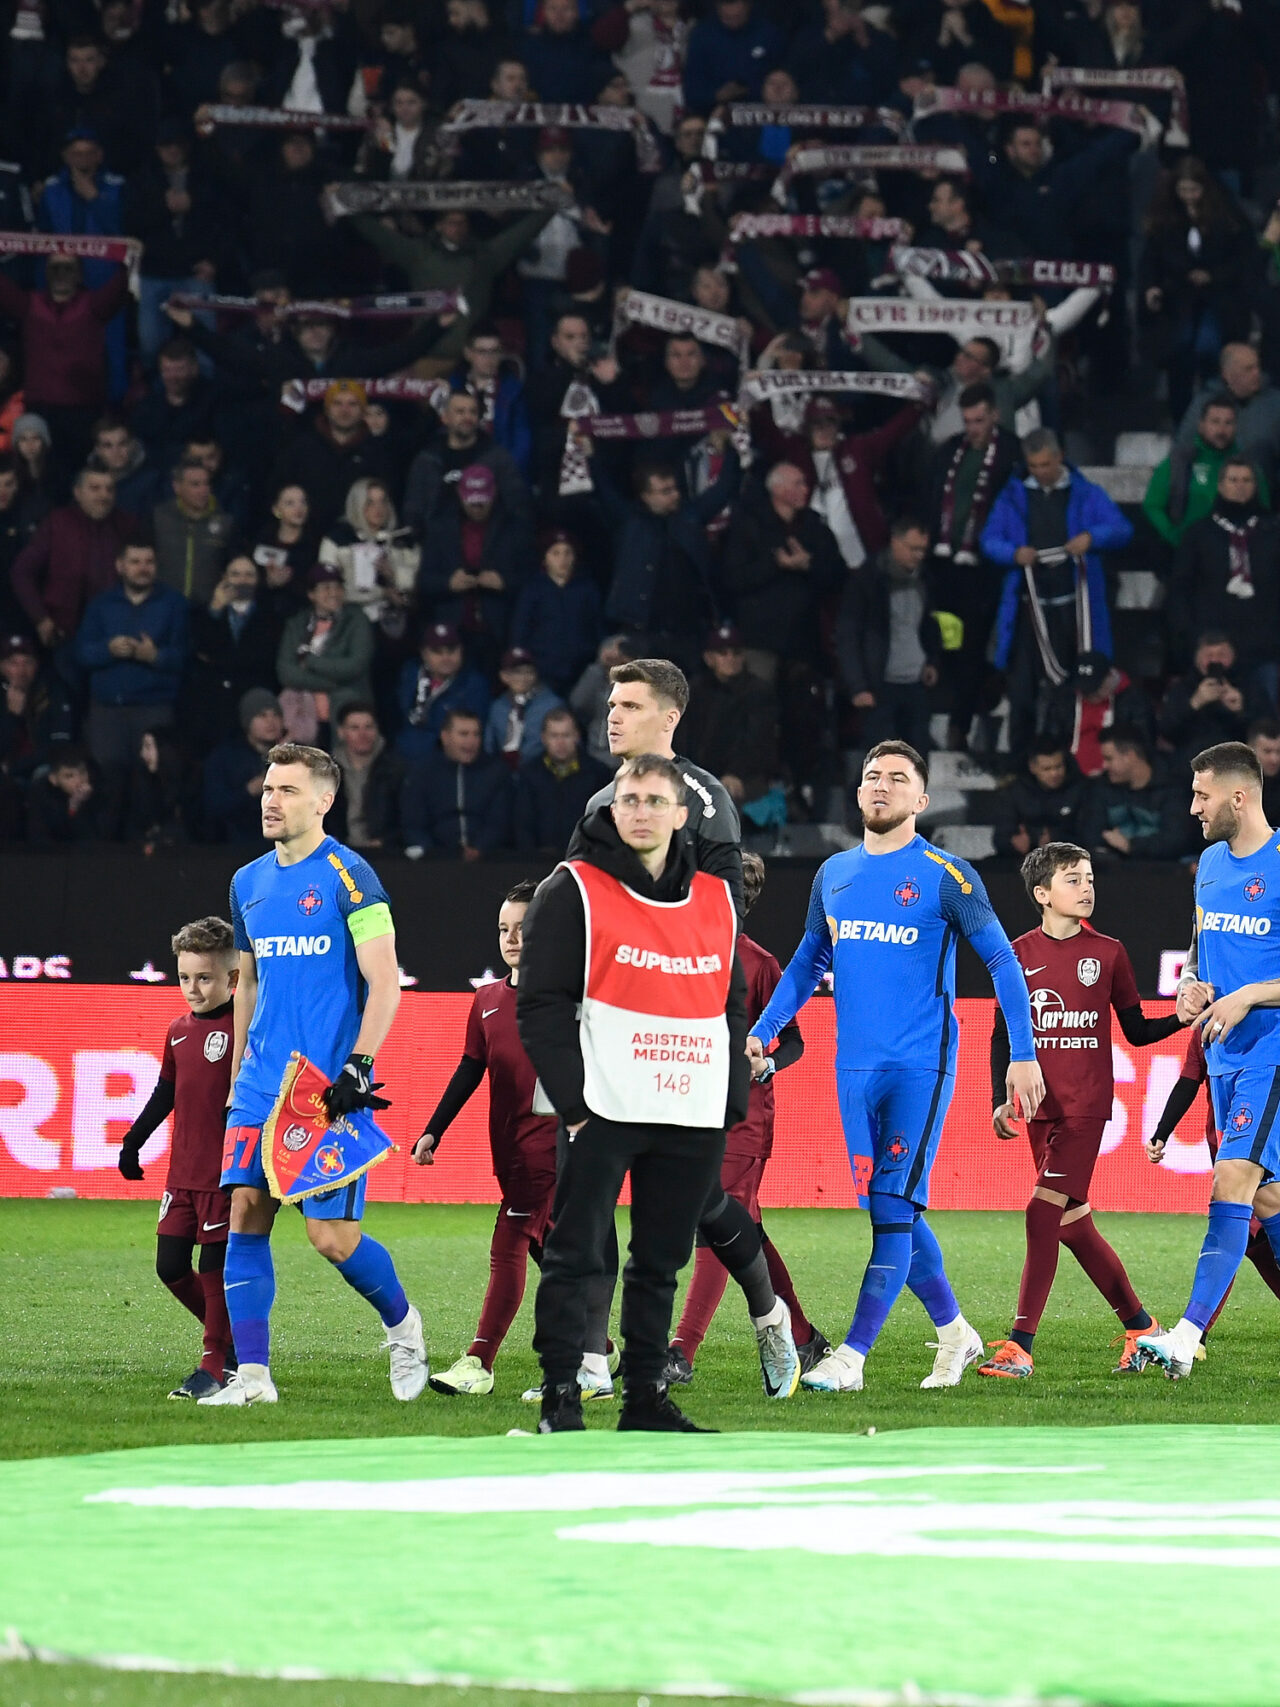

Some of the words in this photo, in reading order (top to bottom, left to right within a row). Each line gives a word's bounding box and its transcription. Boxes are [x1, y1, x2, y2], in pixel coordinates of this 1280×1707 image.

[1033, 260, 1091, 284] CLUJ
[855, 305, 907, 323] CFR
[918, 305, 968, 323] 1907
[838, 919, 919, 945] BETANO
[1202, 912, 1271, 936] BETANO
[254, 935, 331, 959] BETANO
[614, 944, 722, 975] SUPERLIGA
[631, 1032, 713, 1049] ASISTENTA
[1033, 1036, 1059, 1049] NTT
[1060, 1036, 1099, 1049] DATA
[633, 1048, 711, 1065] MEDICALA
[653, 1072, 691, 1095] 148
[222, 1127, 261, 1173] 27
